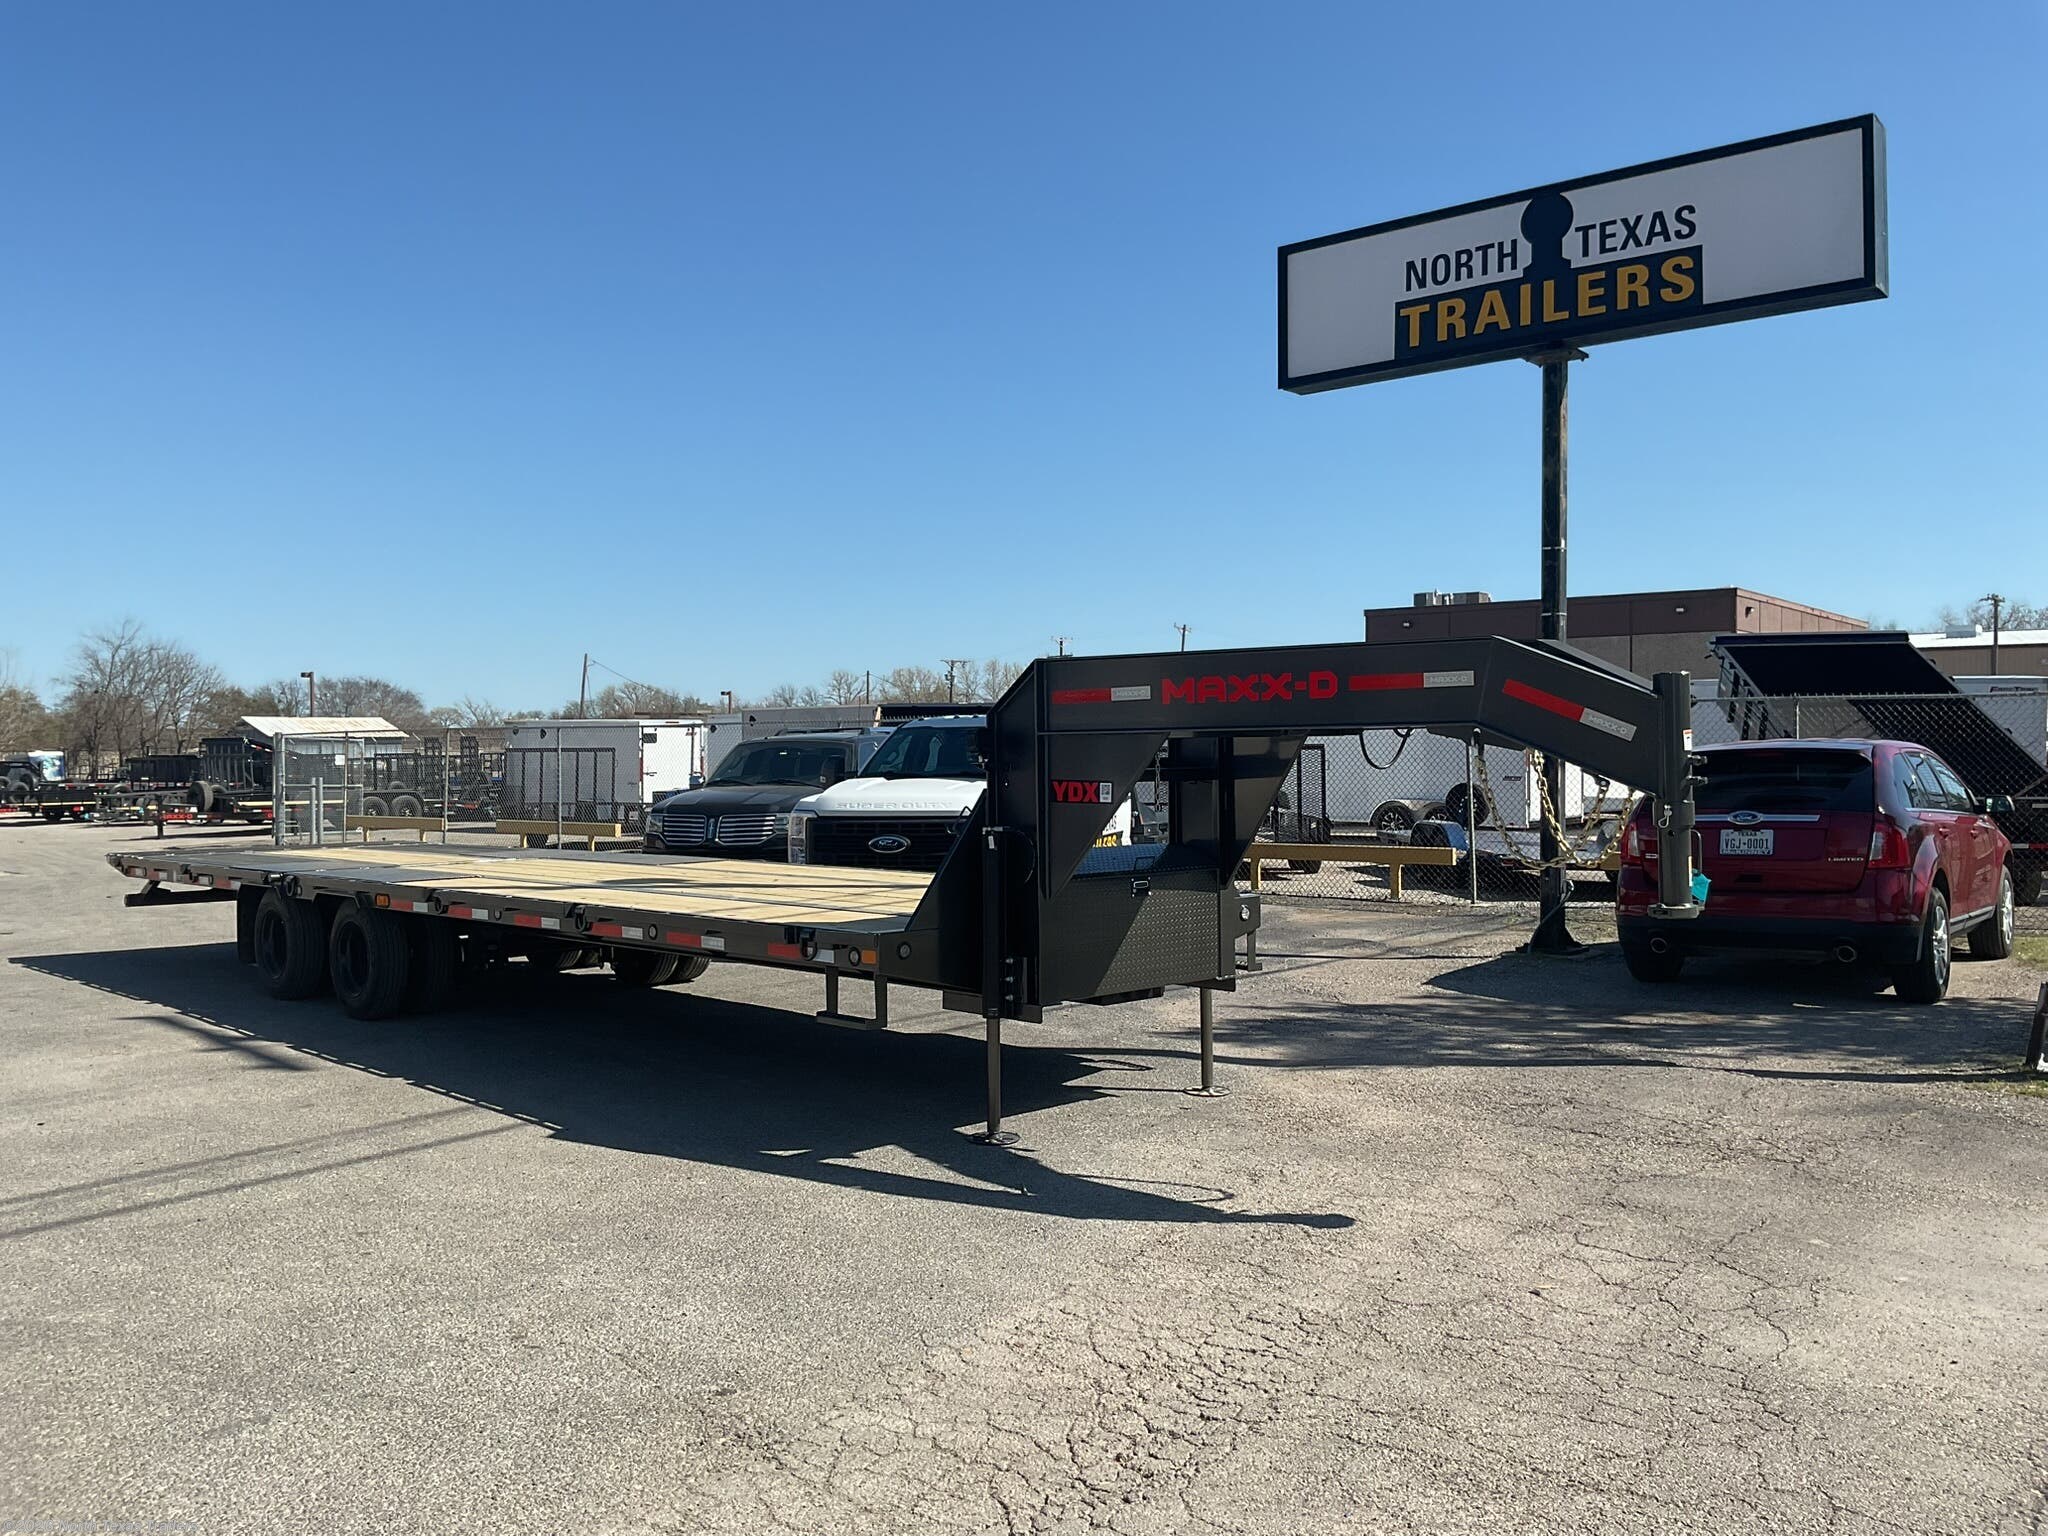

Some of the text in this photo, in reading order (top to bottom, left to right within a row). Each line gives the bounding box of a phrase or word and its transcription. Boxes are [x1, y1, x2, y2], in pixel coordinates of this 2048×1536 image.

[1404, 204, 1697, 292] NORTH TEXAS
[1400, 255, 1695, 348] TRAILERS
[1161, 670, 1338, 704] MAXX-D
[1429, 673, 1469, 684] MAXX-D
[1053, 781, 1098, 803] YDX
